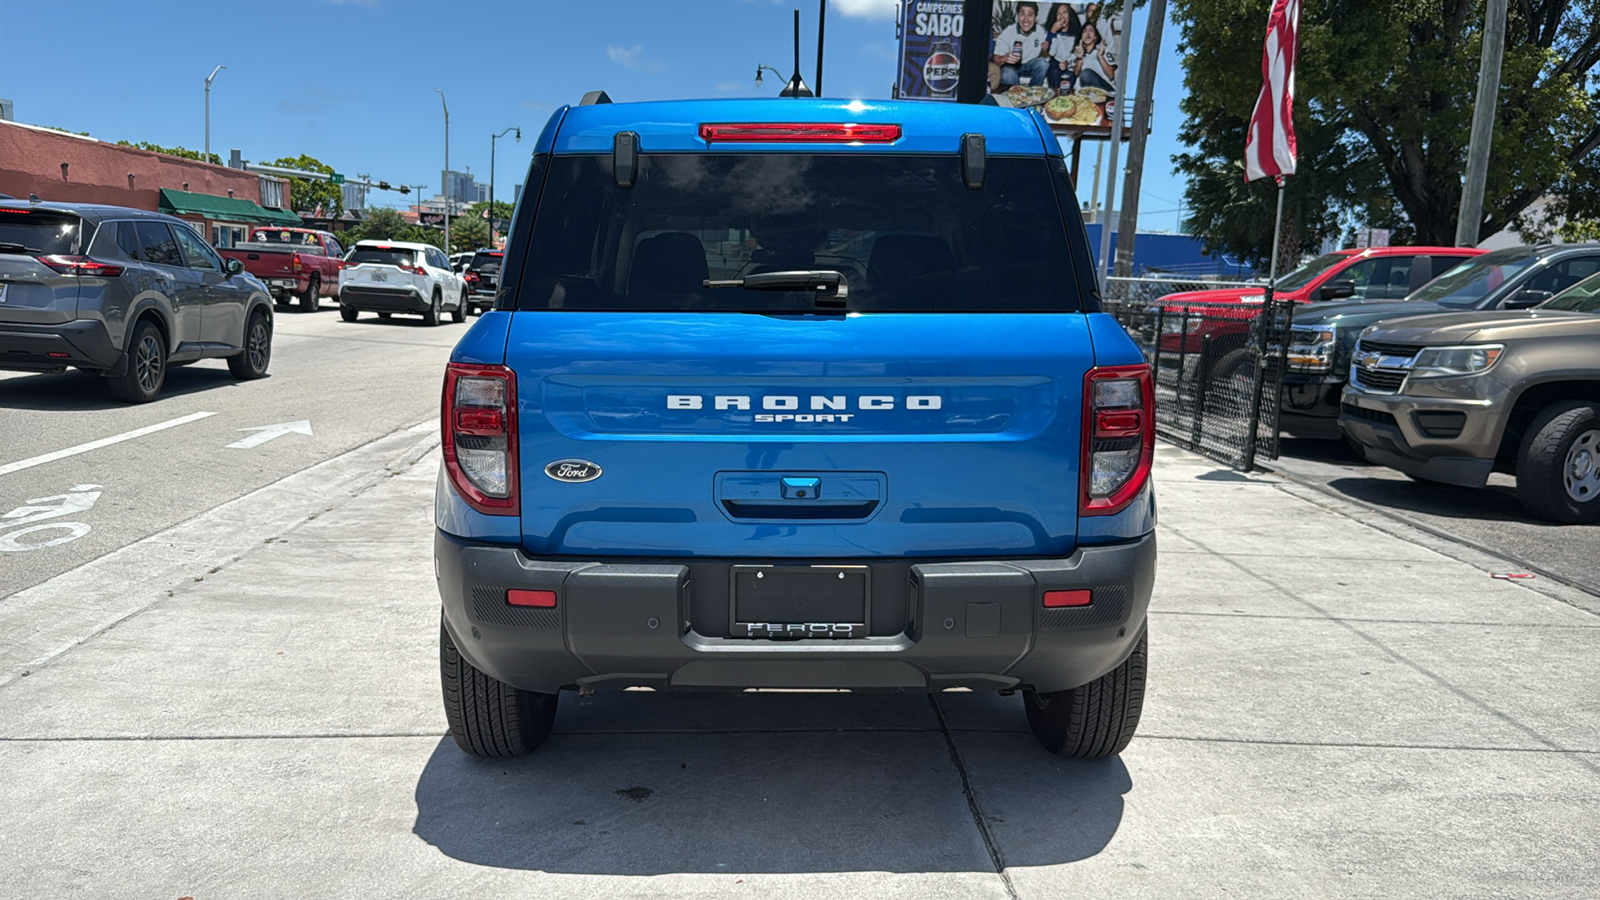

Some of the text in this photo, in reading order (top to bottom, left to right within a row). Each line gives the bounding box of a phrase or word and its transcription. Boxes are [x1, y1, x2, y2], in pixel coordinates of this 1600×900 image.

[916, 2, 963, 14] CAMPEONES
[915, 13, 965, 37] SABO
[666, 394, 943, 411] BRONCO
[754, 414, 855, 423] SPORT
[557, 463, 589, 478] Ford
[747, 623, 853, 632] FERCO
